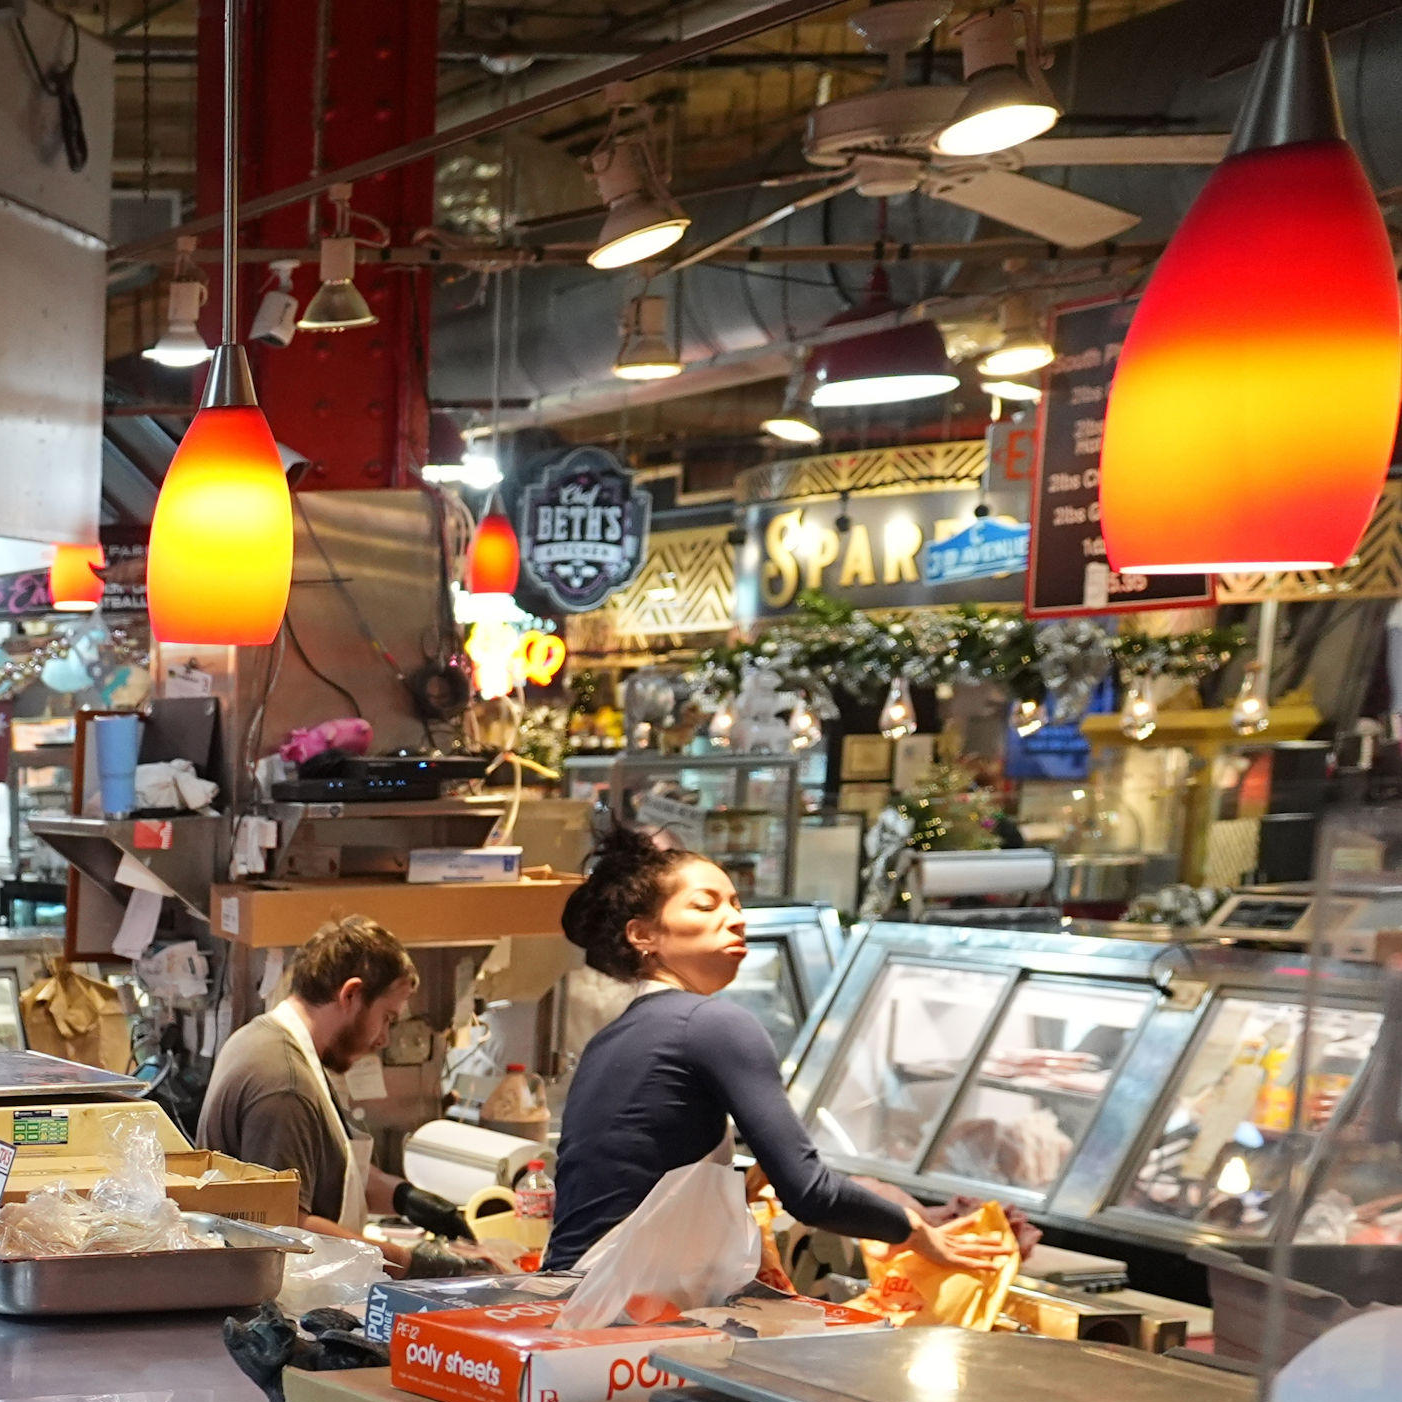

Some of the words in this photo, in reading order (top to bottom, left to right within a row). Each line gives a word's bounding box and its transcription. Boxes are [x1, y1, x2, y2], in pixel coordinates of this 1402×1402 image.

[537, 506, 622, 541] BETH'S
[395, 1321, 421, 1340] PE-12
[406, 1342, 444, 1372] poly
[445, 1351, 501, 1387] sheets
